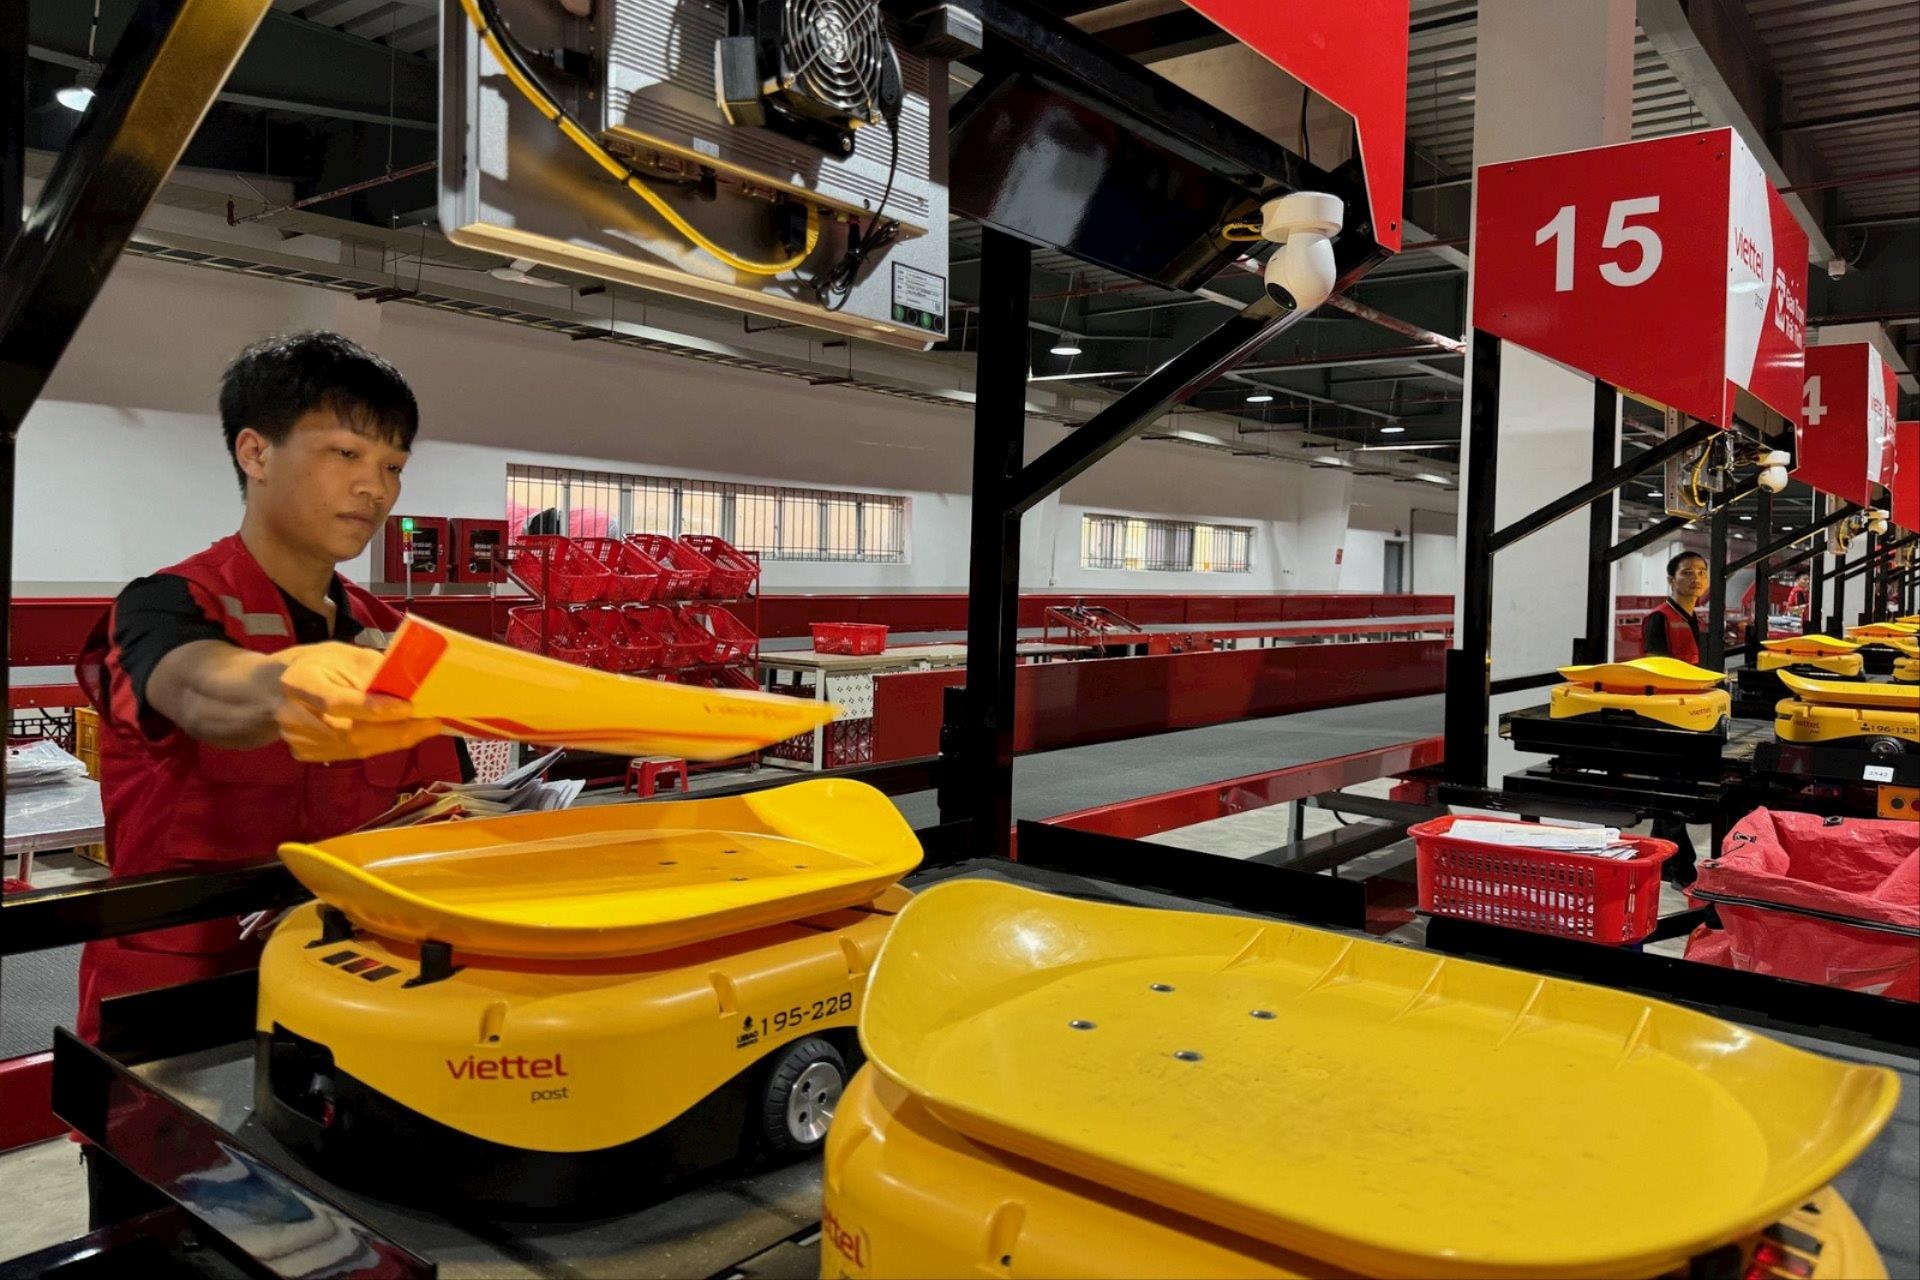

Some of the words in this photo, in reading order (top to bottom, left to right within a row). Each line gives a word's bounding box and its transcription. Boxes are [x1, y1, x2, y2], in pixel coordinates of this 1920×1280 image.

[1535, 195, 1663, 292] 15
[1734, 226, 1764, 282] viettel
[761, 991, 852, 1037] 195-228
[445, 1053, 570, 1080] viettel
[530, 1086, 569, 1103] post
